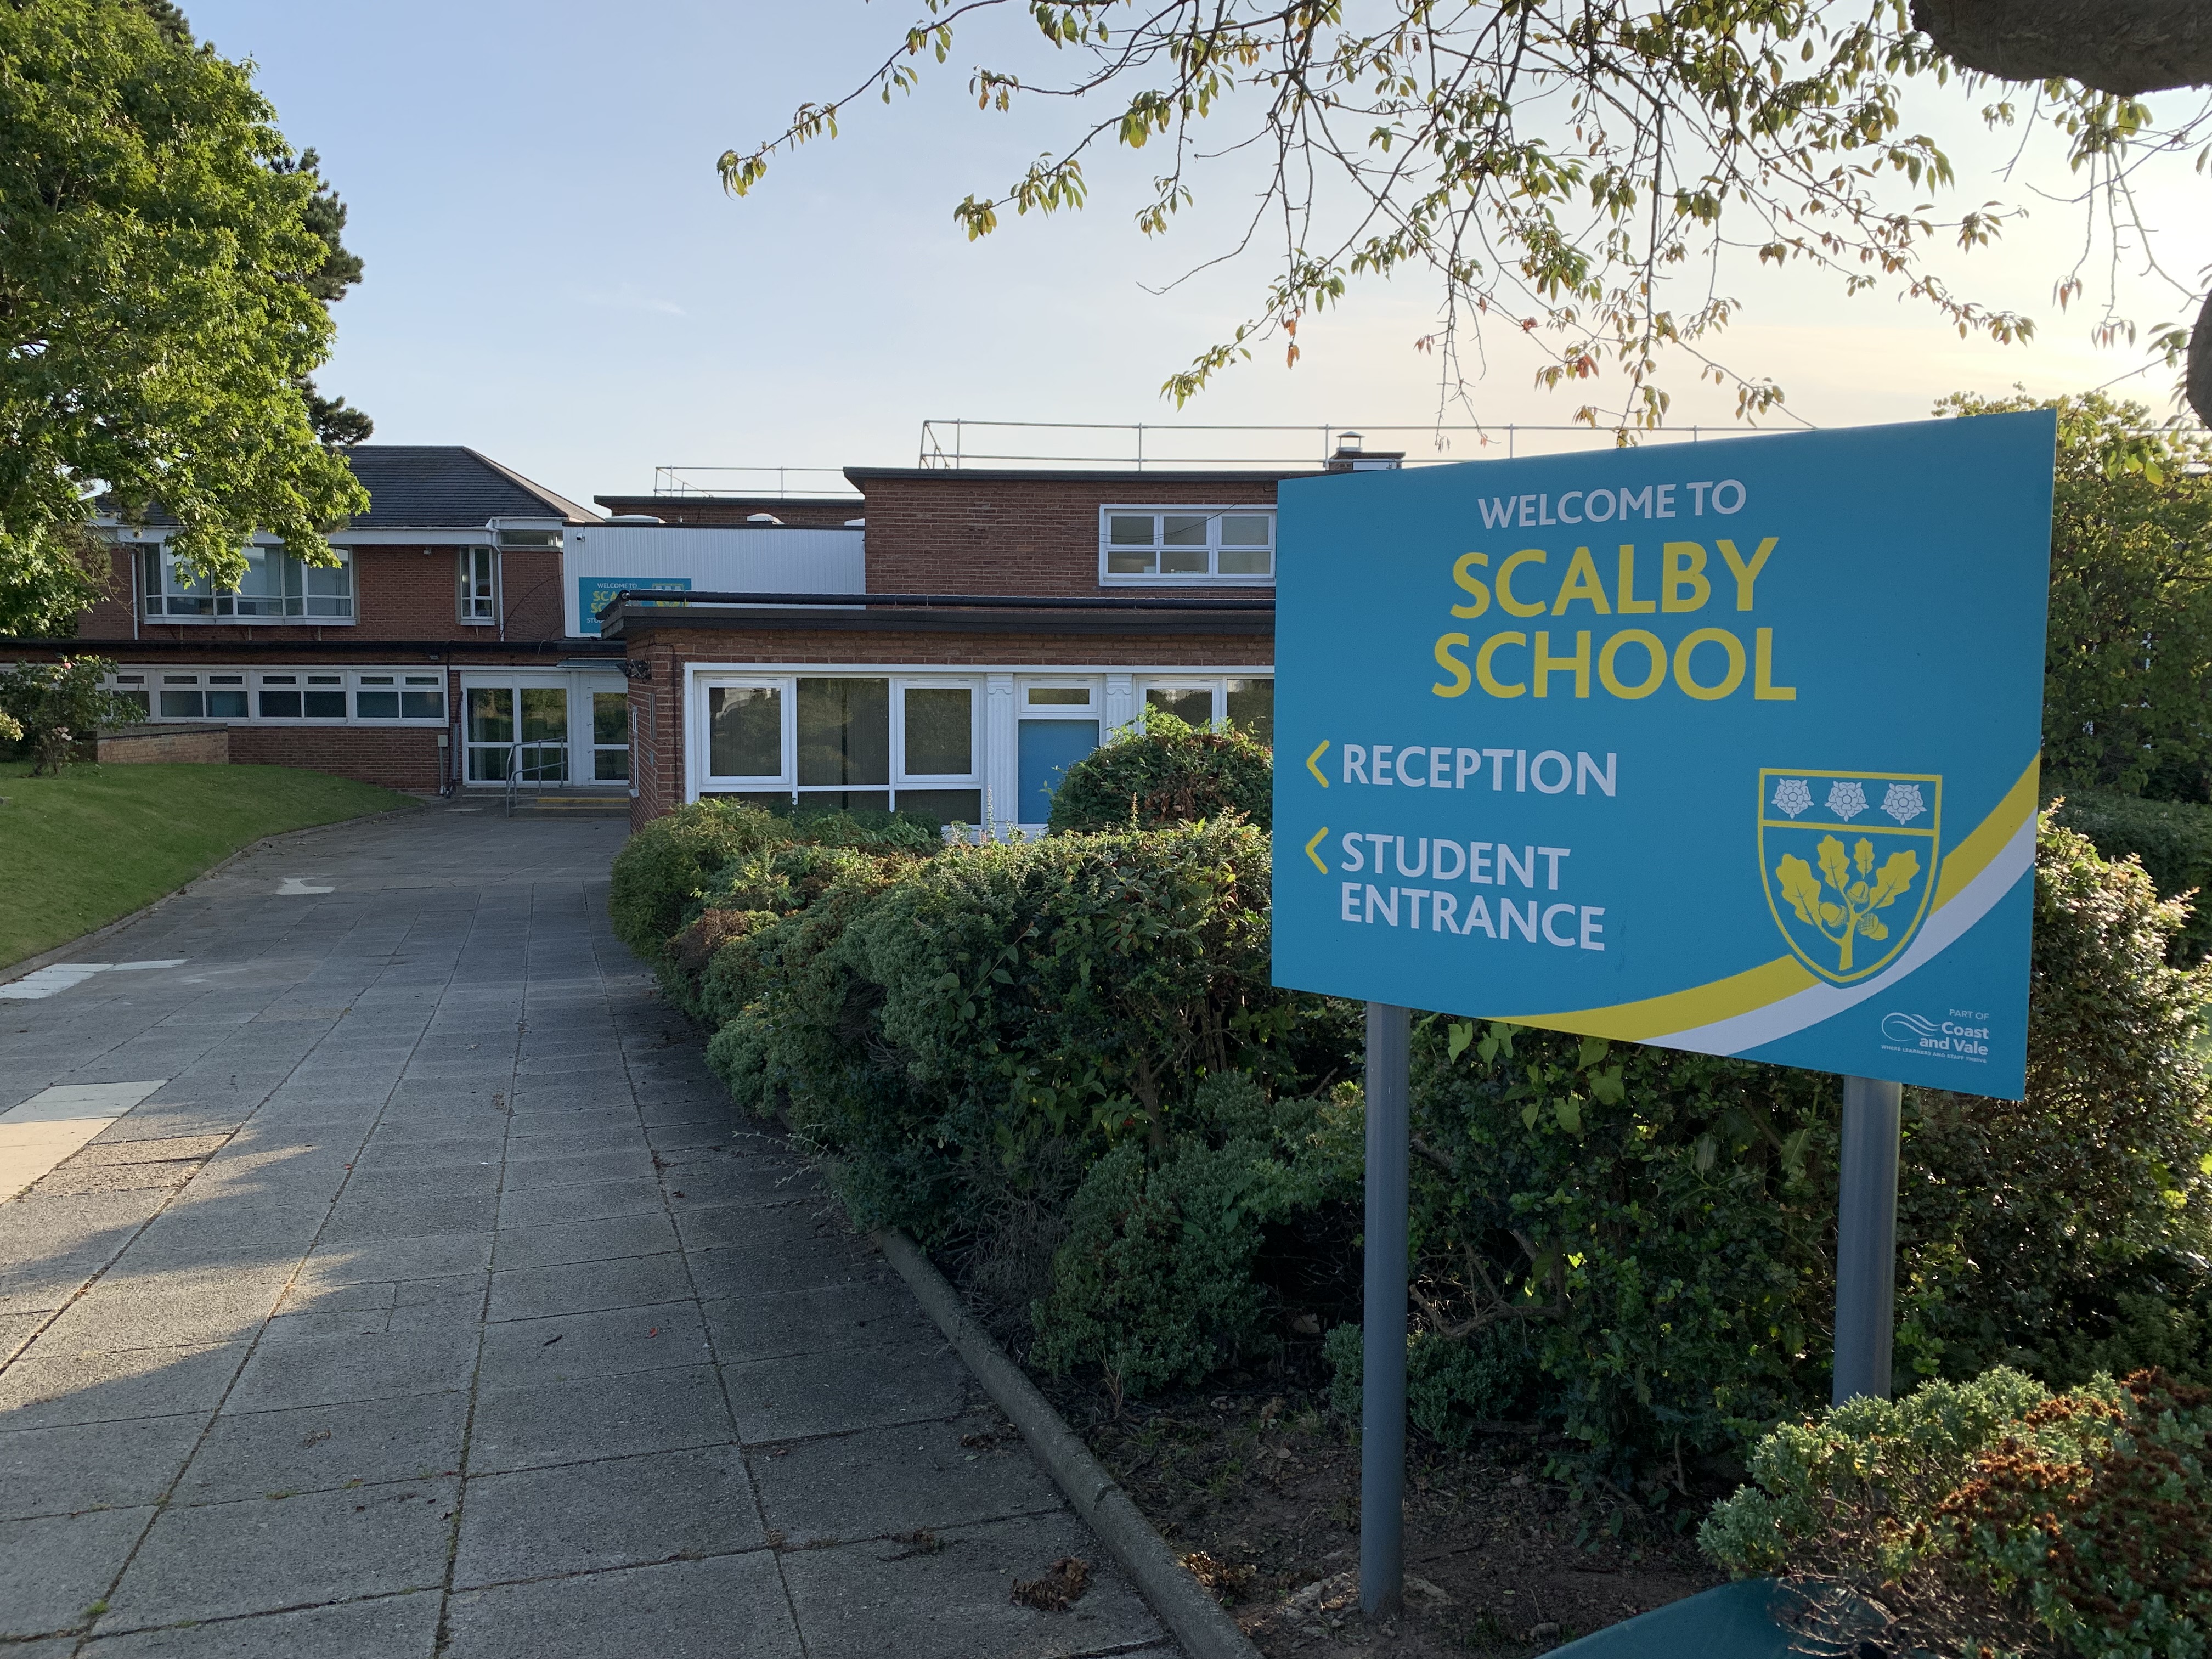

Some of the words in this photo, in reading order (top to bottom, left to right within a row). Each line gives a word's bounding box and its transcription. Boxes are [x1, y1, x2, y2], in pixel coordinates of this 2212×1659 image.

[1478, 483, 1677, 529] WELCOME
[1686, 479, 1747, 516] TO
[1449, 537, 1780, 619] SCALBY
[1432, 627, 1797, 701] SCHOOL
[1343, 744, 1617, 797] RECEPTION
[1340, 832, 1571, 890] STUDENT
[1341, 882, 1606, 951] ENTRANCE
[1941, 1021, 1990, 1040] Coast
[1949, 1009, 1973, 1019] PART
[1975, 1012, 1990, 1020] OF
[1902, 1047, 1932, 1056] LEARNERS
[1965, 1056, 1988, 1064] THRIVE
[1920, 1037, 1950, 1050] and
[1953, 1038, 1989, 1056] Vale
